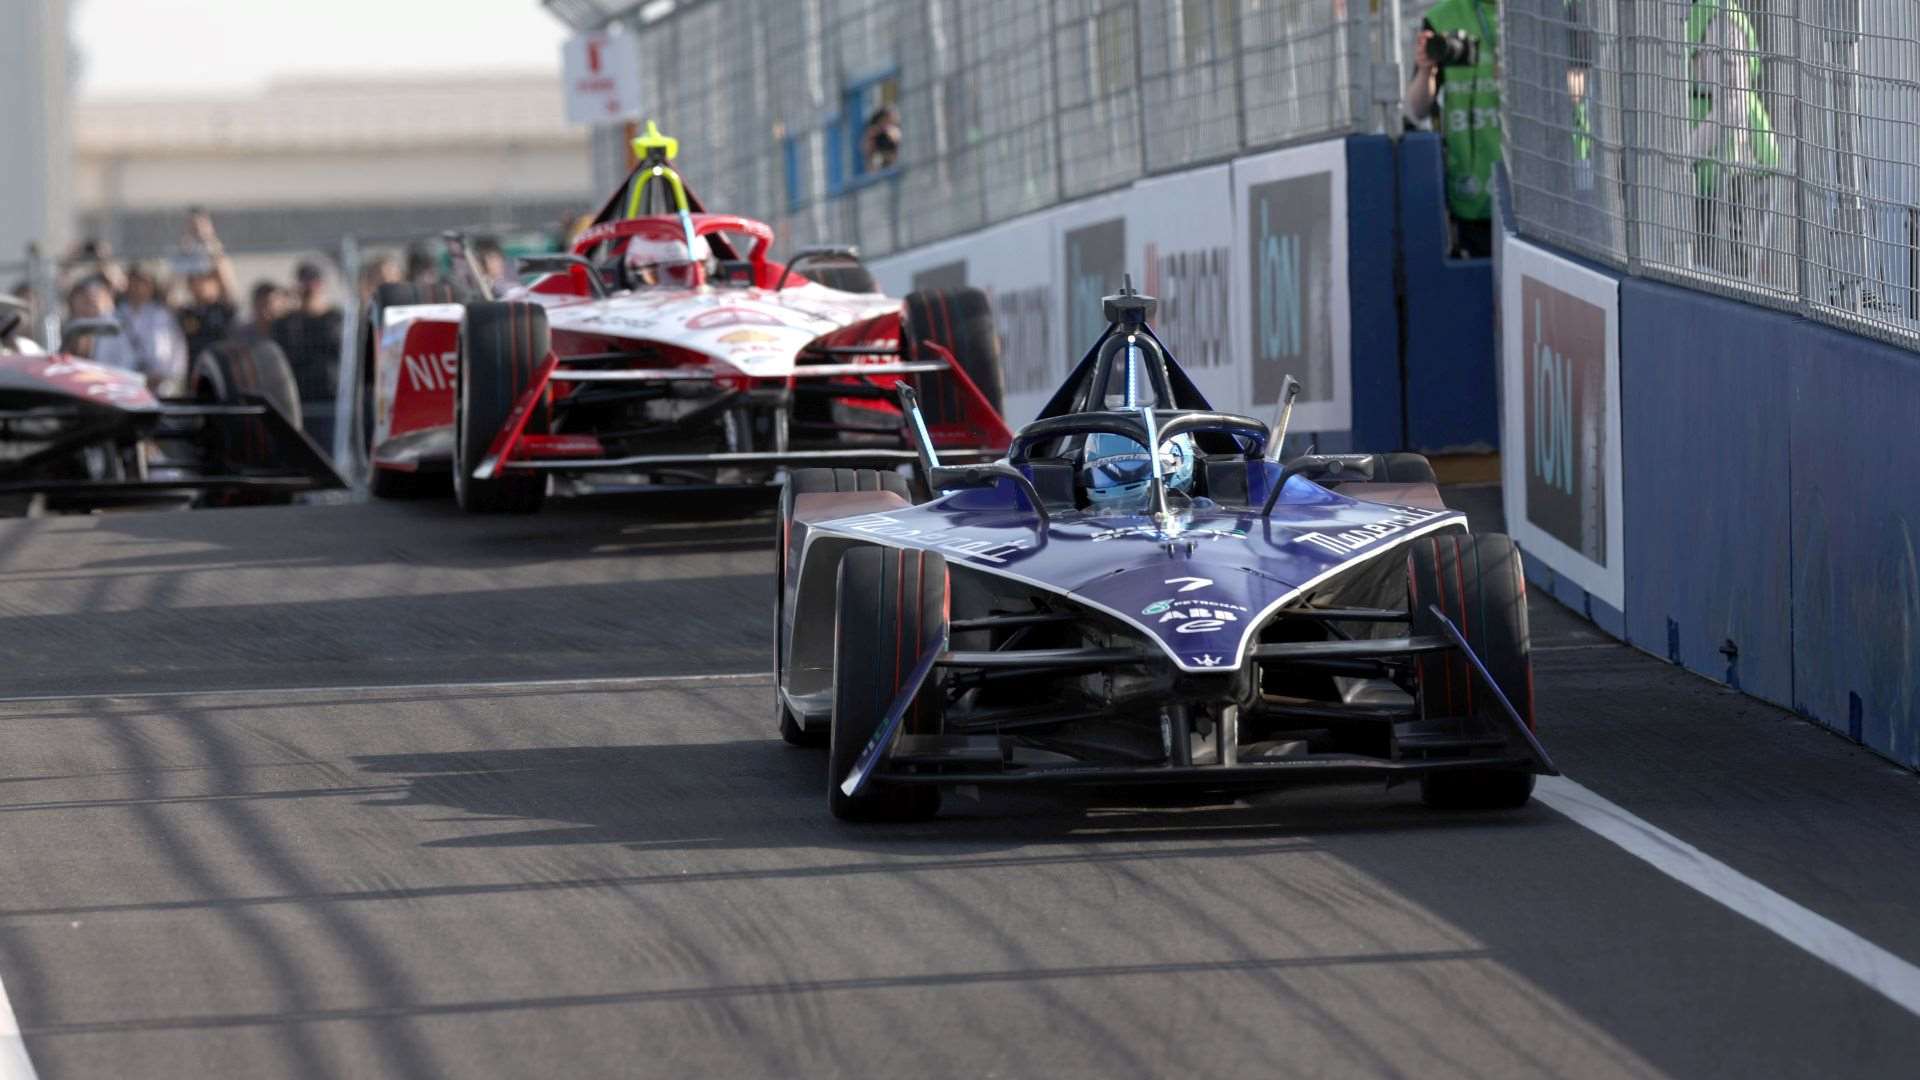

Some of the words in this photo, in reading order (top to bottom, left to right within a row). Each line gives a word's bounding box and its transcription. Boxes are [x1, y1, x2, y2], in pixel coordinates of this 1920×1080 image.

[1533, 299, 1573, 495] iON
[1164, 576, 1214, 593] 7
[1174, 600, 1248, 612] PETRONAS
[1158, 608, 1238, 623] ABB
